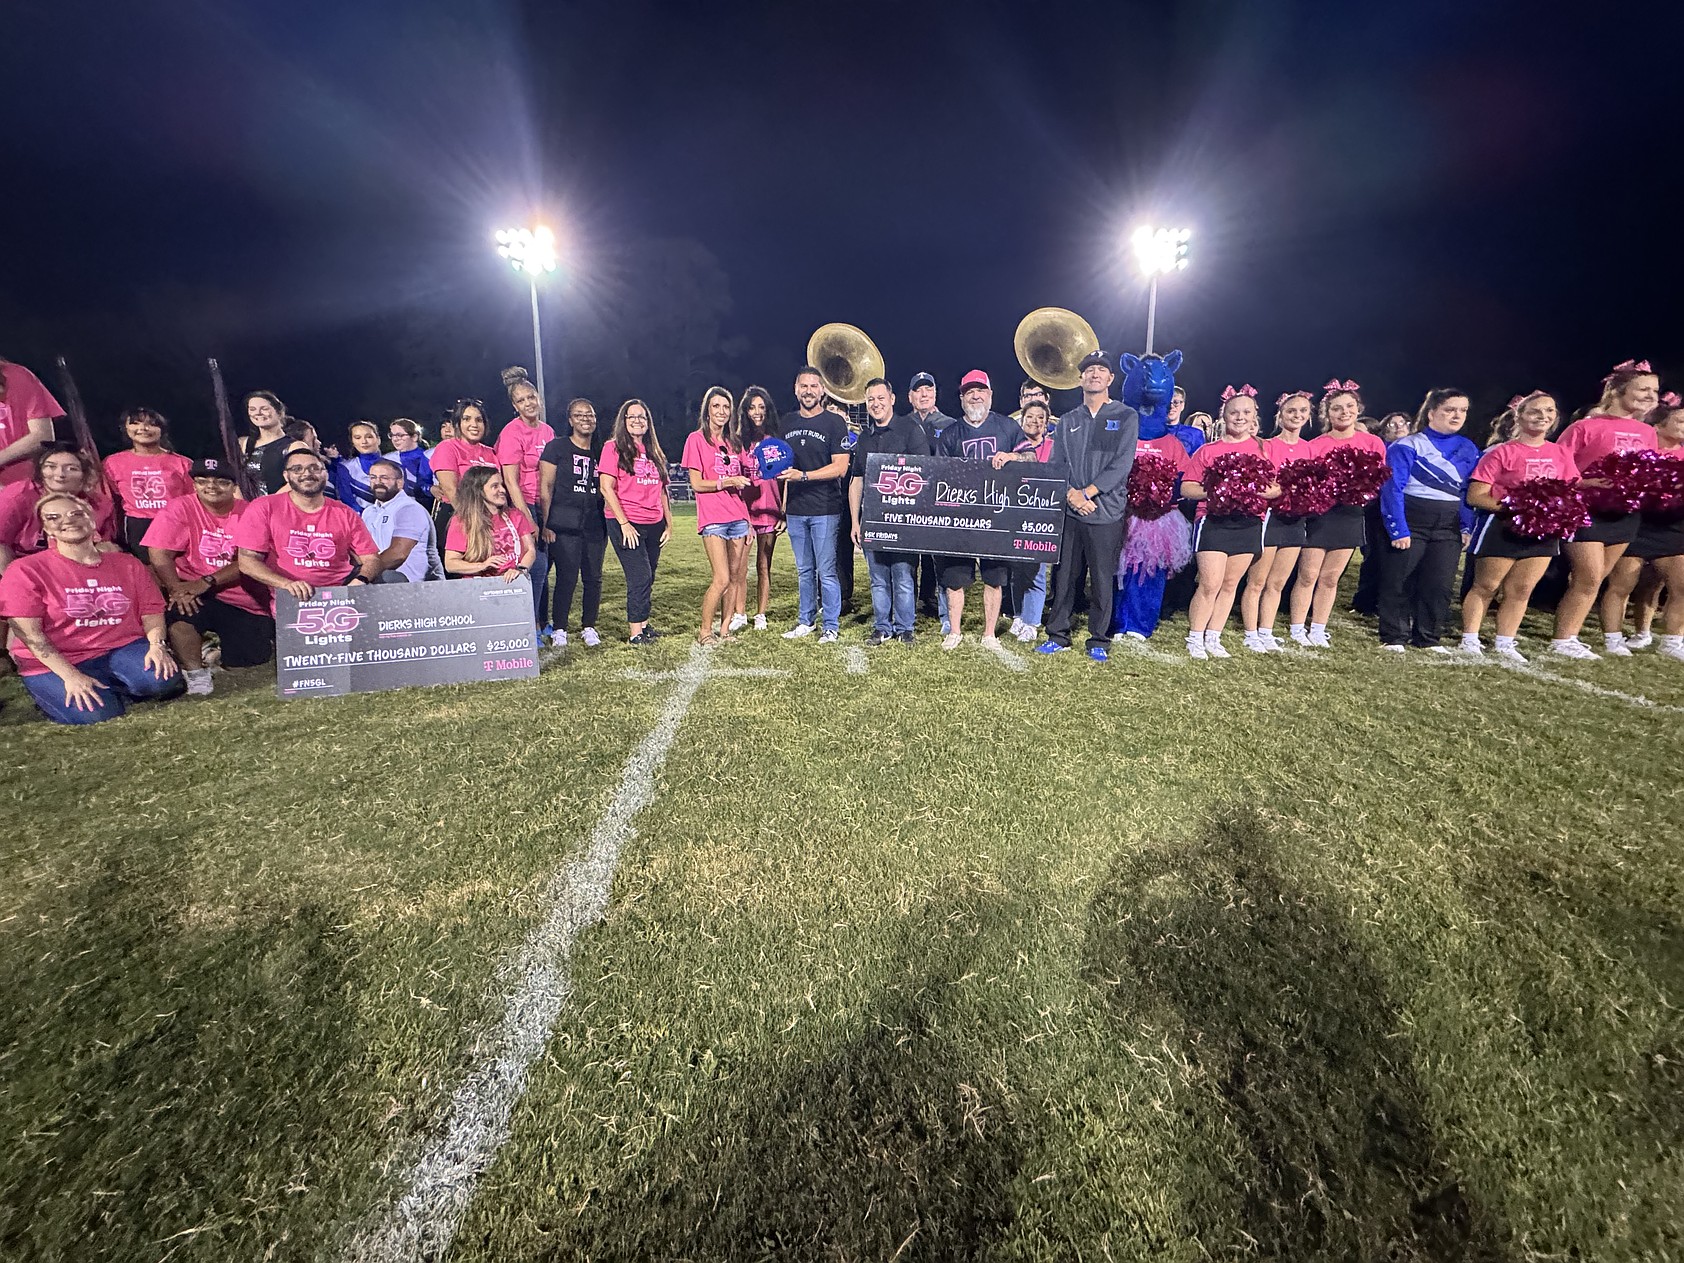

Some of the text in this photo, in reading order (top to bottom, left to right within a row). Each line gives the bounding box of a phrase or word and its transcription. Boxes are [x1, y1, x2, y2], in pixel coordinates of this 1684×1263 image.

[808, 430, 826, 442] RURAL
[881, 464, 902, 472] Friday
[636, 477, 660, 486] Lights
[873, 471, 927, 496] 5G
[881, 495, 916, 505] Lights
[984, 480, 1011, 513] High
[135, 499, 168, 509] LIGHTS
[882, 512, 992, 529] FIVE THOUSAND DOLLARS
[1021, 520, 1055, 533] $5,000
[289, 529, 312, 537] Friday
[285, 535, 337, 559] 5G
[1013, 539, 1057, 552] T Mobile
[294, 557, 330, 568] Lights
[96, 585, 122, 593] Night
[298, 598, 356, 608] Friday Night
[75, 617, 122, 628] Lights
[291, 606, 364, 635] 5G
[378, 613, 475, 631] DIERKS HIGH SCHOOL
[304, 633, 353, 646] Lights
[486, 638, 529, 651] $25,000
[283, 641, 477, 667] TWENTY-FIVE THOUSAND DOLLARS
[483, 657, 533, 671] T Mobile
[292, 678, 326, 689] #FN5GL
